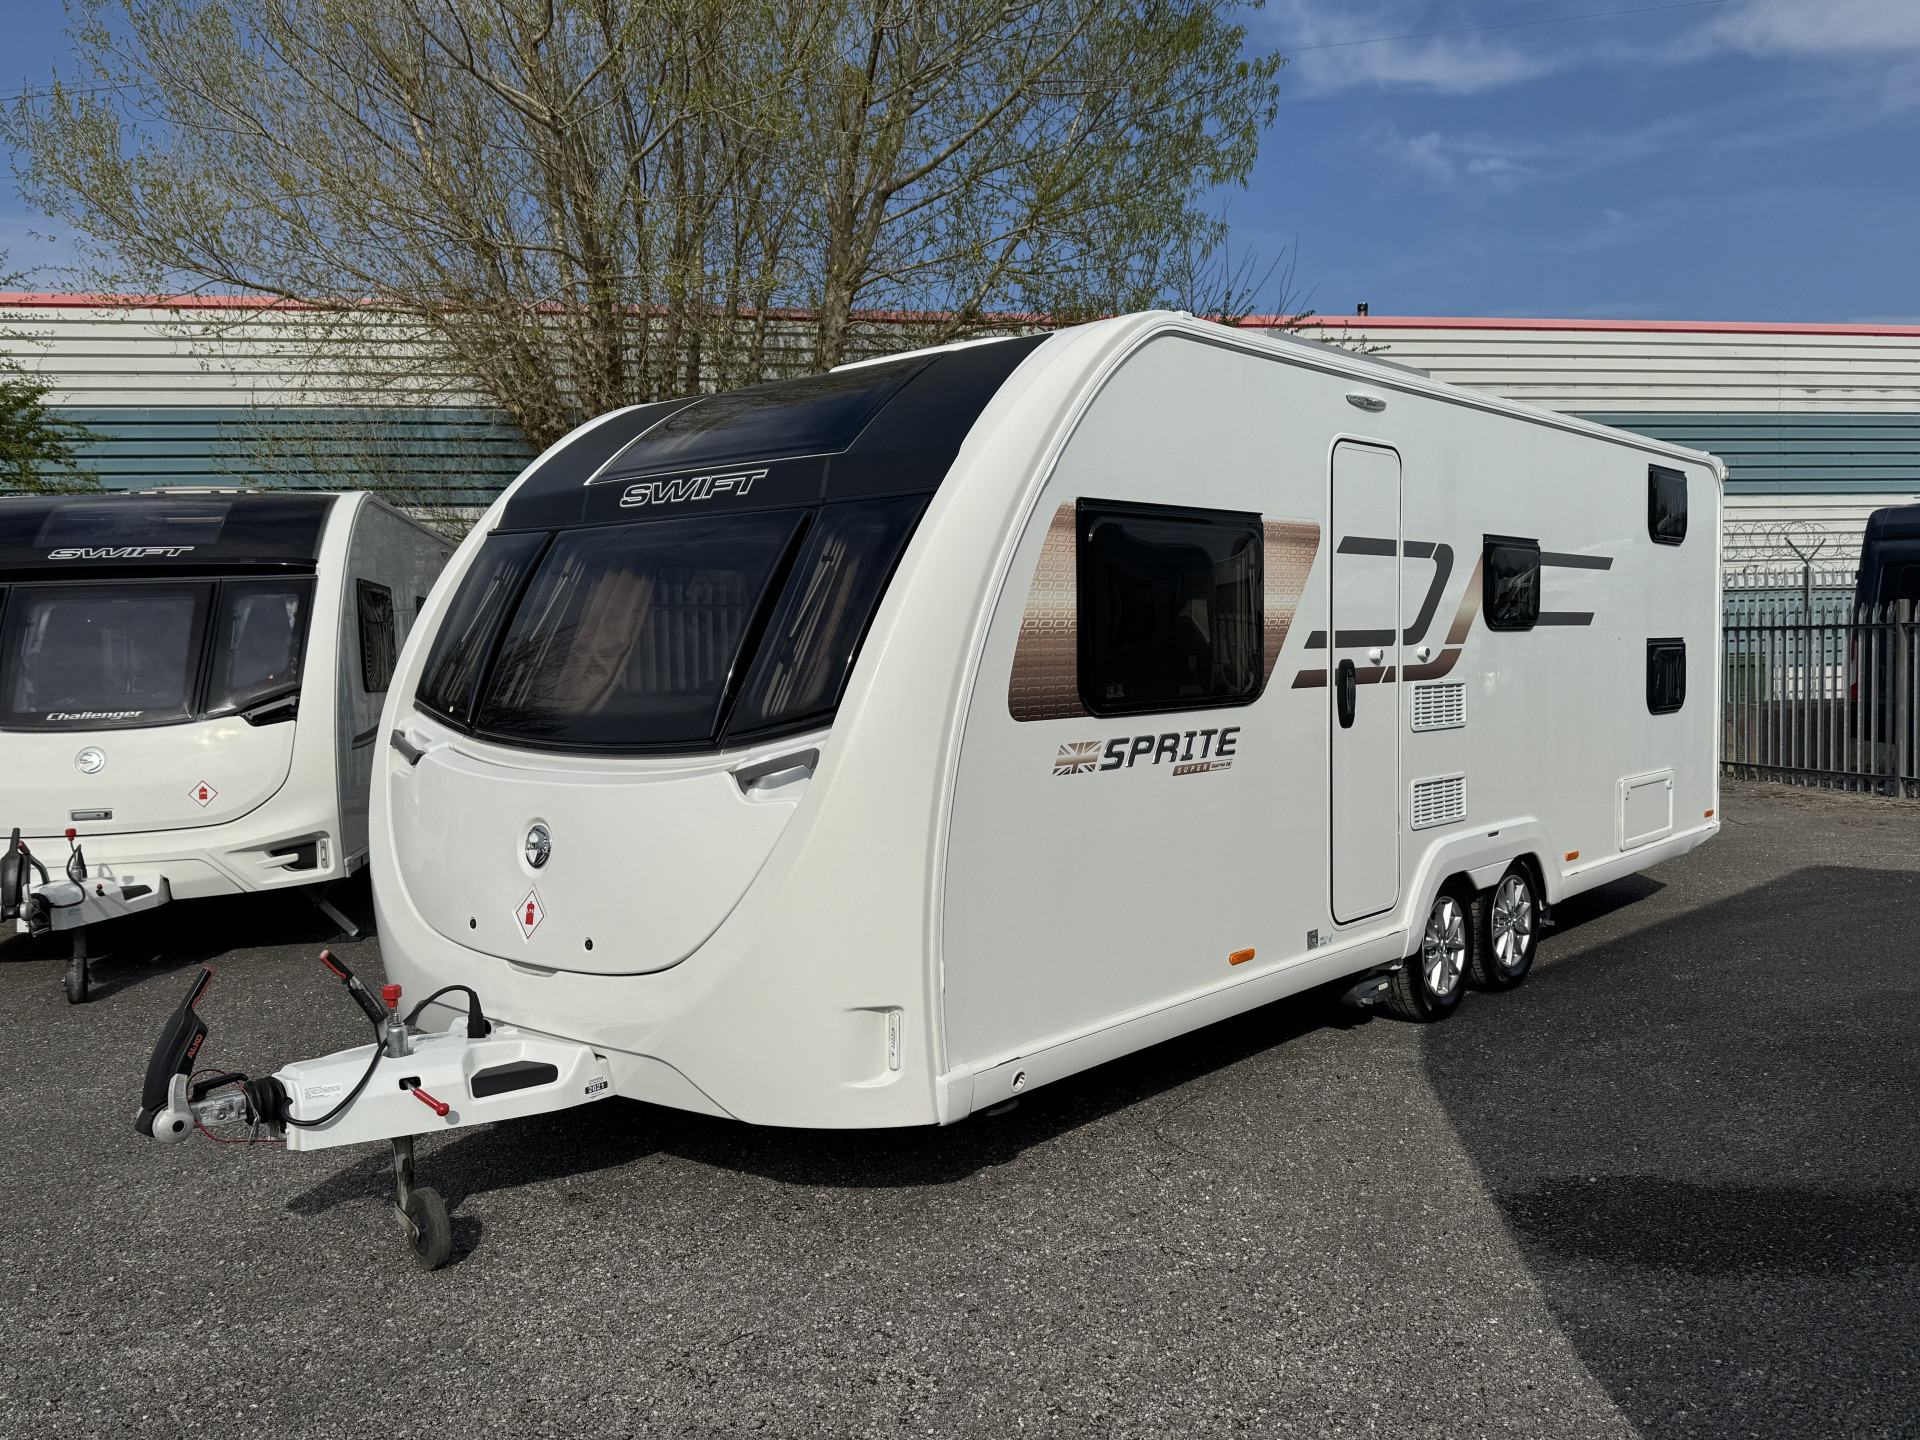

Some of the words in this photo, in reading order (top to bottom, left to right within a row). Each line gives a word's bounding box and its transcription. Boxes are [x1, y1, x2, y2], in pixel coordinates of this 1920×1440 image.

[619, 468, 770, 508] SWIFT
[47, 546, 195, 560] SWIFT
[46, 710, 144, 721] Challenger
[1099, 726, 1241, 771] SPRITE
[1176, 763, 1208, 774] SUPER
[587, 1082, 605, 1094] 2021
